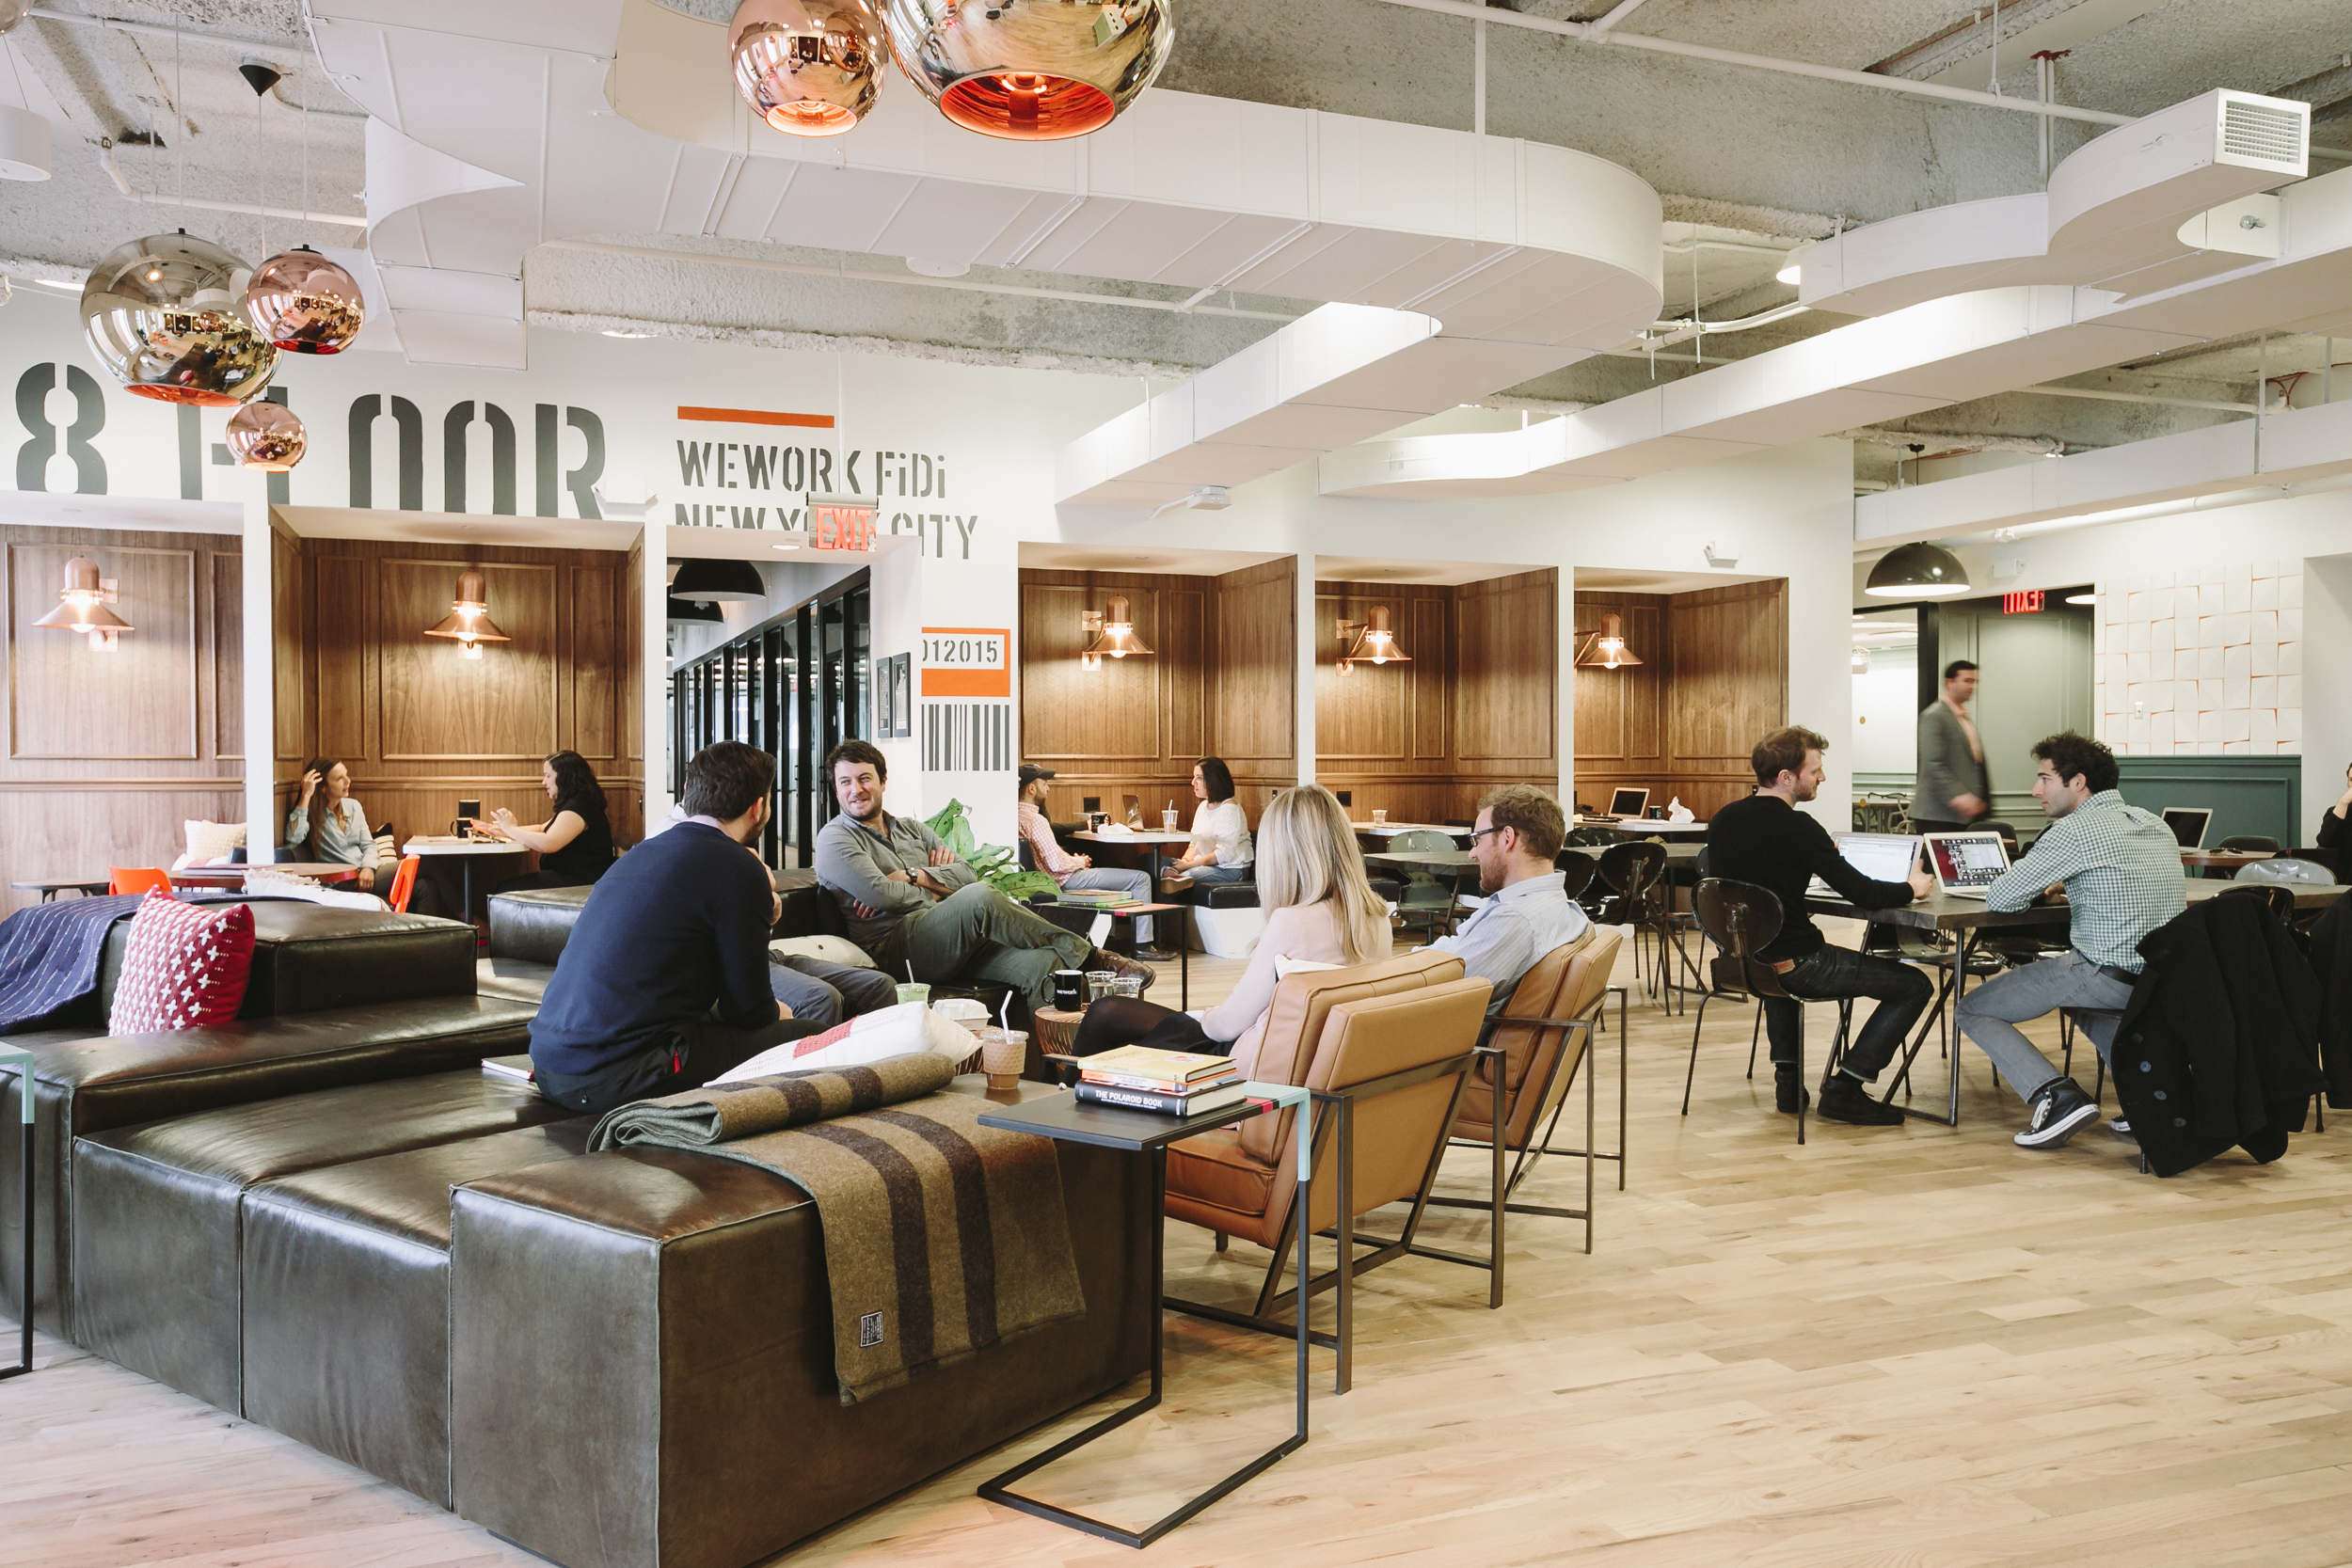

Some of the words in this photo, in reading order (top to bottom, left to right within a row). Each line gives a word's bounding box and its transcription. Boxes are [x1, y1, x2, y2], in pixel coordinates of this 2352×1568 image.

[15, 362, 107, 496] 8
[676, 439, 861, 494] WEWORK
[817, 506, 872, 552] EXIT
[1095, 1089, 1108, 1099] THE
[1108, 1090, 1143, 1104] POLAROID
[1143, 1097, 1163, 1108] BOOK
